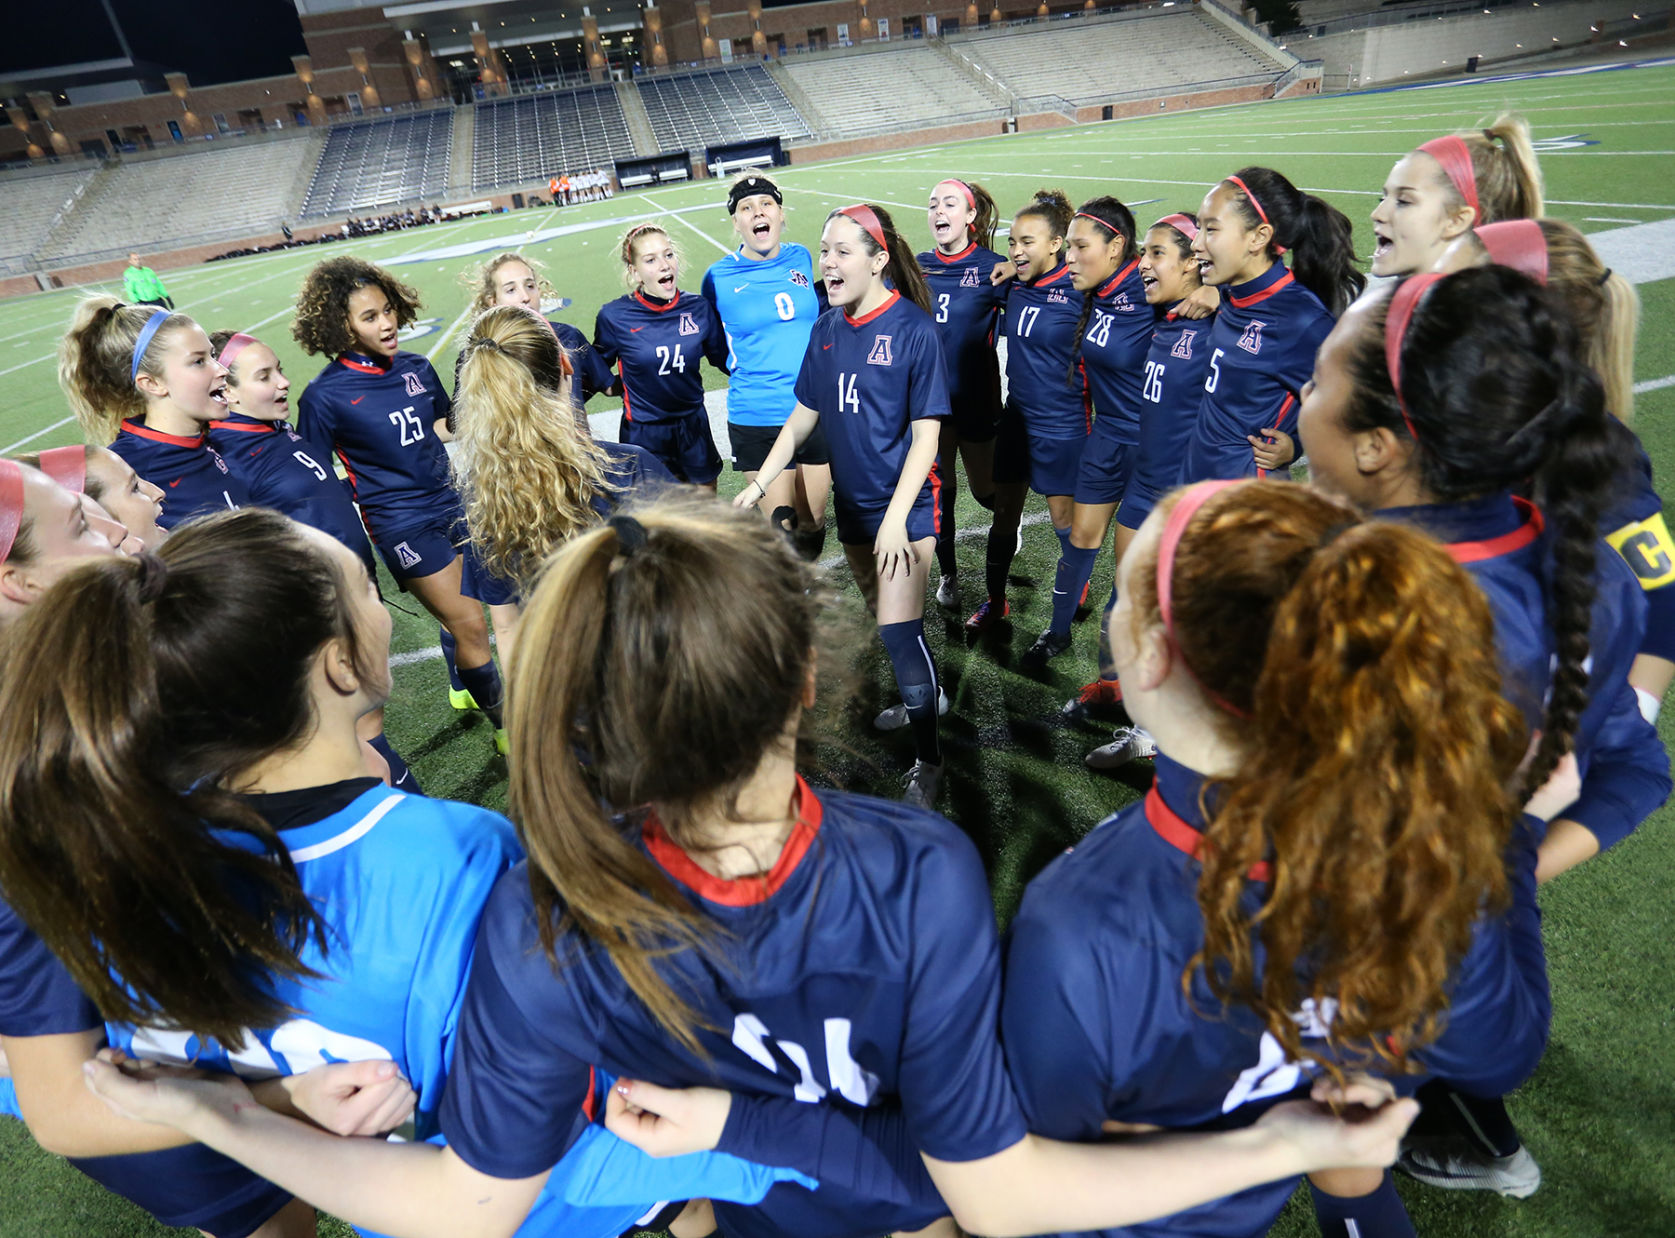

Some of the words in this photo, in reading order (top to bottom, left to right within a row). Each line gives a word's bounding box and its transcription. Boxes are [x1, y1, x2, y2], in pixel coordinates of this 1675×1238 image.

[958, 267, 980, 288] A
[774, 292, 795, 321] 0
[936, 293, 950, 324] 3
[1017, 306, 1041, 338] 17
[679, 312, 700, 337] A
[1086, 308, 1115, 348] 28
[1236, 319, 1267, 355] A
[656, 344, 686, 376] 24
[866, 334, 892, 365] A
[1170, 329, 1198, 360] A
[402, 373, 427, 396] A
[1142, 361, 1166, 404] 26
[1205, 347, 1225, 394] 5
[837, 372, 860, 413] 14
[389, 406, 425, 447] 25
[293, 450, 328, 481] 9
[394, 541, 422, 570] A
[1622, 531, 1671, 578] C
